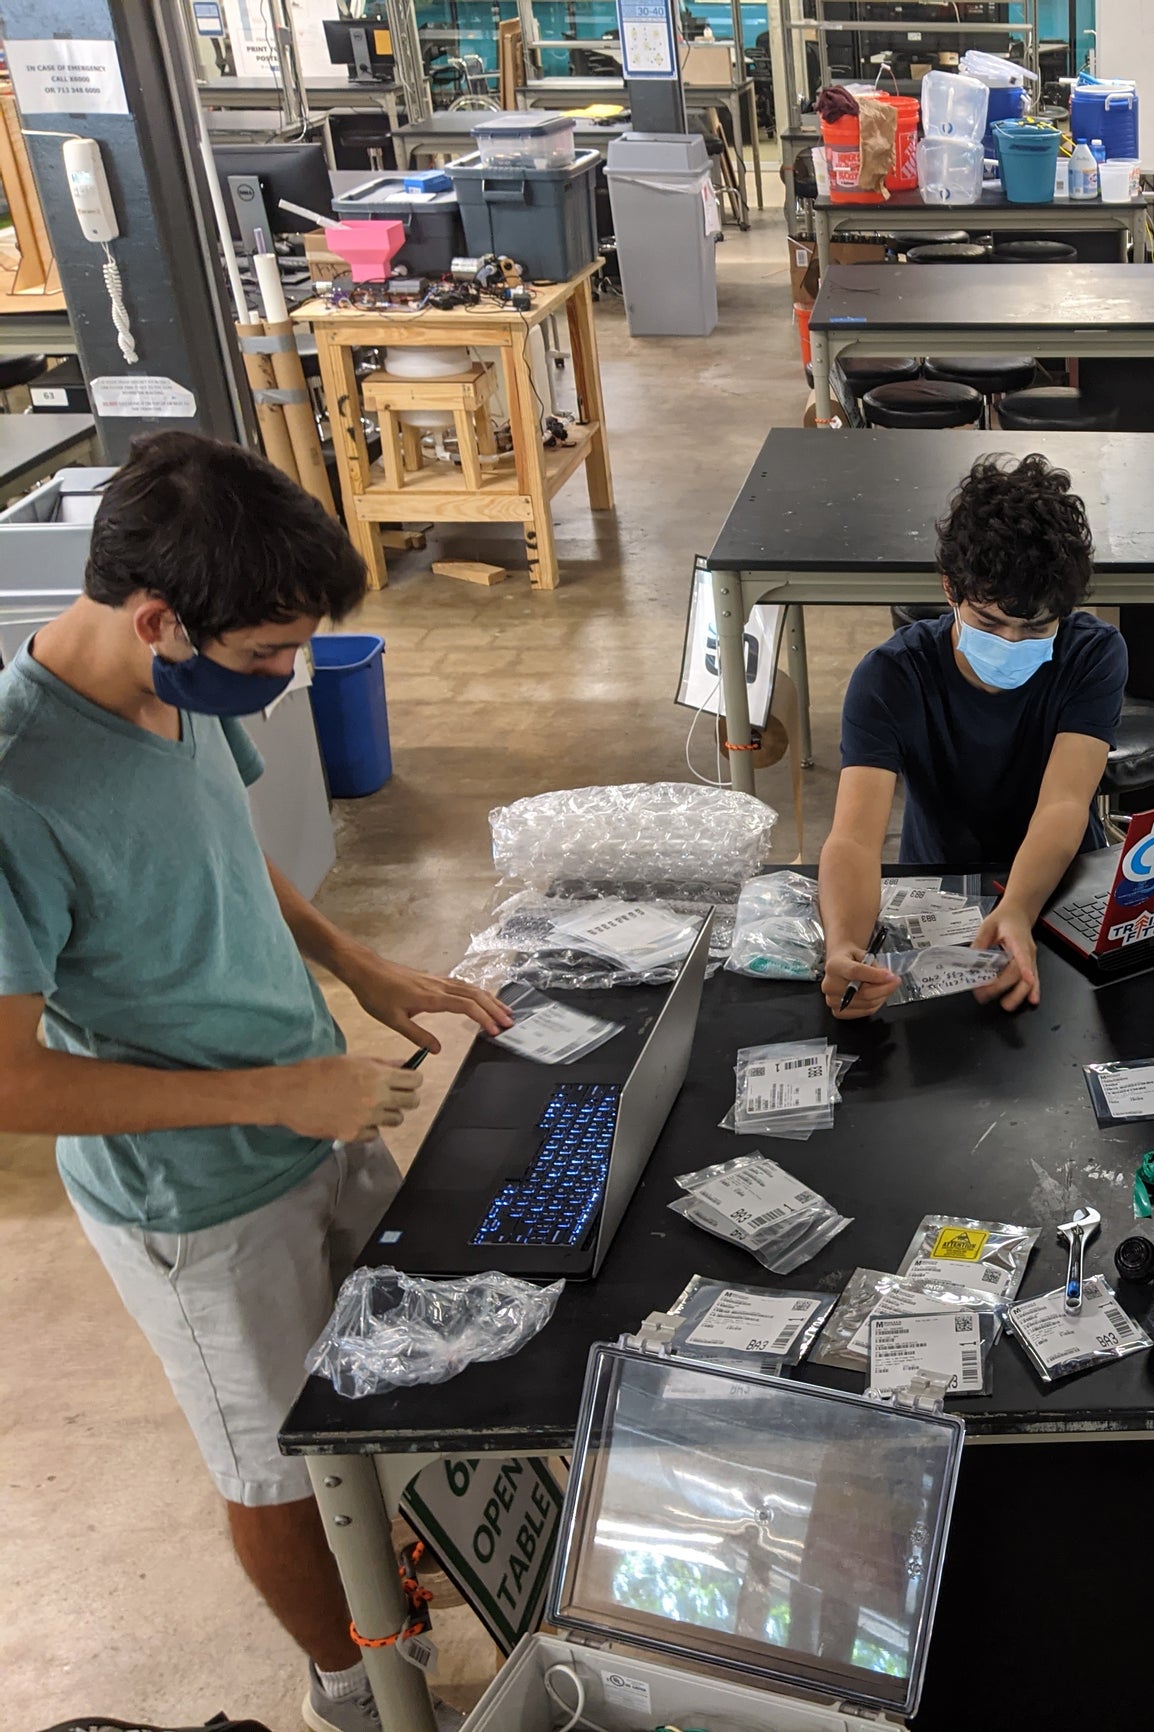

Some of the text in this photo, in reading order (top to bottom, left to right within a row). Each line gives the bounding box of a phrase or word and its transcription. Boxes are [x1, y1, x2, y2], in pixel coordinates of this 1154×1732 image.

[729, 1208, 753, 1224] BA3
[745, 1339, 769, 1351] BA3
[1096, 1332, 1119, 1348] BA3
[473, 1458, 523, 1564] OPEN
[496, 1481, 550, 1610] TABLE
